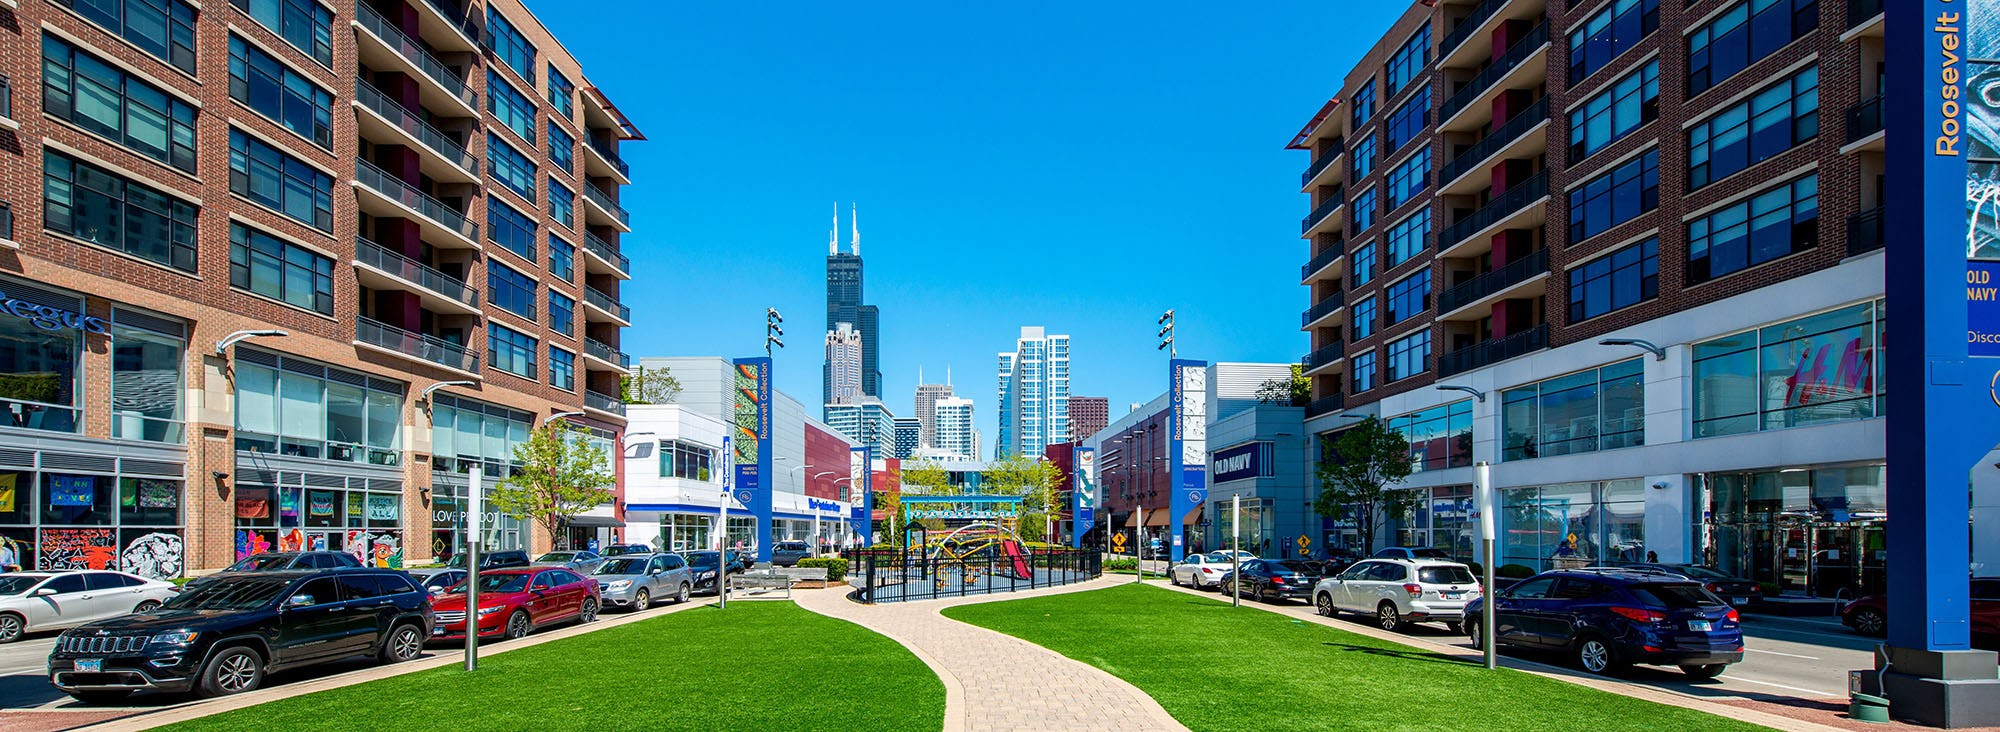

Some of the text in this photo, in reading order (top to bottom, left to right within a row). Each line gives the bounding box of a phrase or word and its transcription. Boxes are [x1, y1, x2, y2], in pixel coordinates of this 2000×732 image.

[1935, 11, 1960, 156] Roosevelt
[1967, 270, 1990, 284] OLD
[1967, 287, 1998, 301] NAVY
[760, 362, 768, 440] Roosevelt Collection
[1174, 364, 1182, 441] Roosevelt Collection
[1214, 452, 1252, 475] OLD NAVY
[432, 510, 457, 522] LOVE
